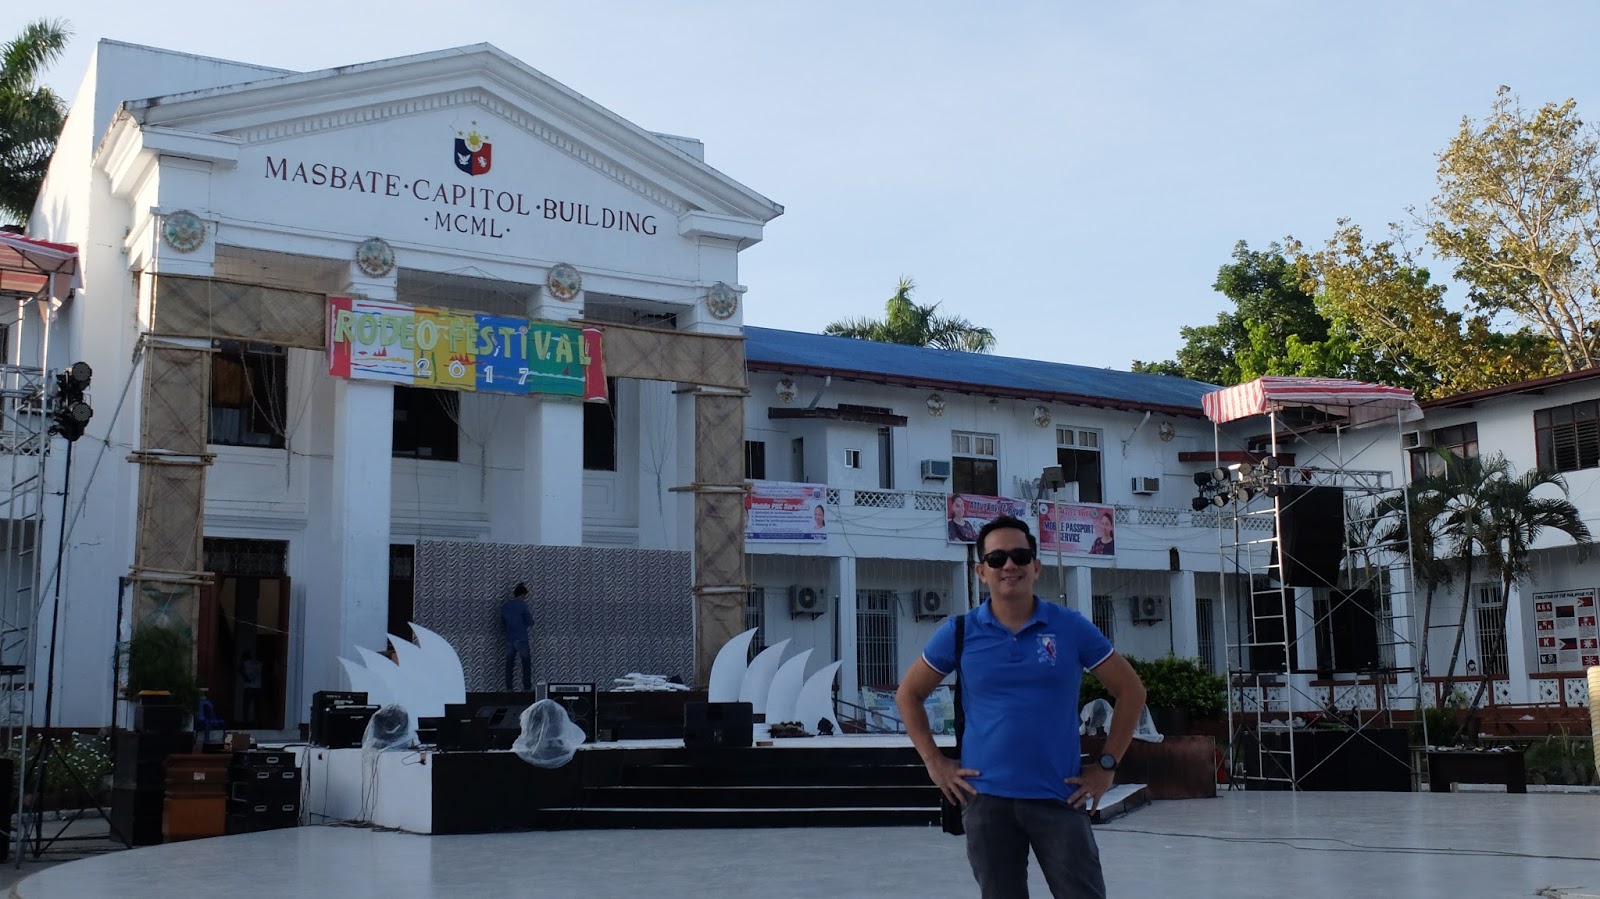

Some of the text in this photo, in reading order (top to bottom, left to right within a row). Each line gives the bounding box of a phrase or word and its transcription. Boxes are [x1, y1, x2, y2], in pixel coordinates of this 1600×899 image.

[265, 155, 659, 236] MASBATE CAPITOL BUILDING
[334, 309, 592, 366] RODEO FESTIVAL
[1044, 521, 1094, 535] MOBE PASSPORT
